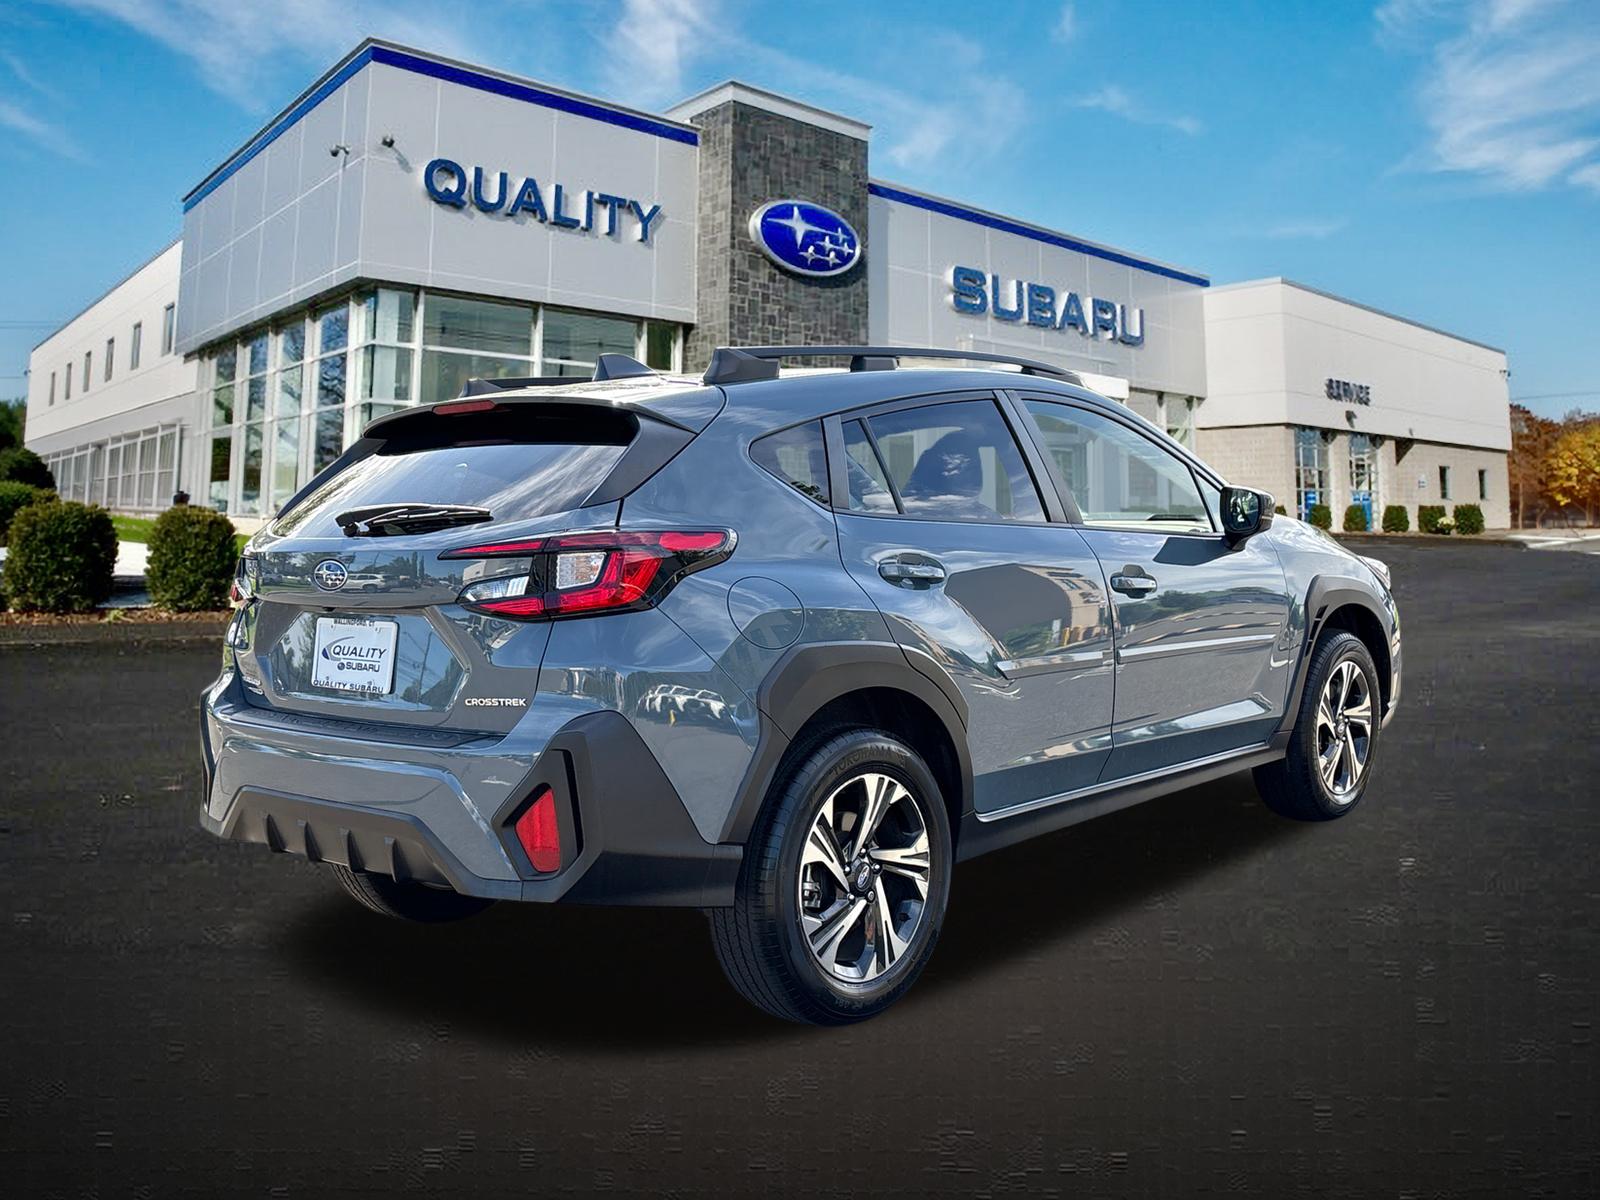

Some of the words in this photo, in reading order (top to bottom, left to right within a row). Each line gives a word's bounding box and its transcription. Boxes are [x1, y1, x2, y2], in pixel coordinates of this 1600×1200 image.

[423, 158, 662, 244] QUALITY
[948, 265, 1145, 347] SUBARU
[1325, 378, 1371, 406] SERVICE
[332, 645, 387, 659] QUALITY
[346, 662, 380, 673] SUBARU
[313, 680, 347, 690] QUALITY
[349, 683, 384, 693] SUBARU
[465, 698, 527, 707] CROSSTREK
